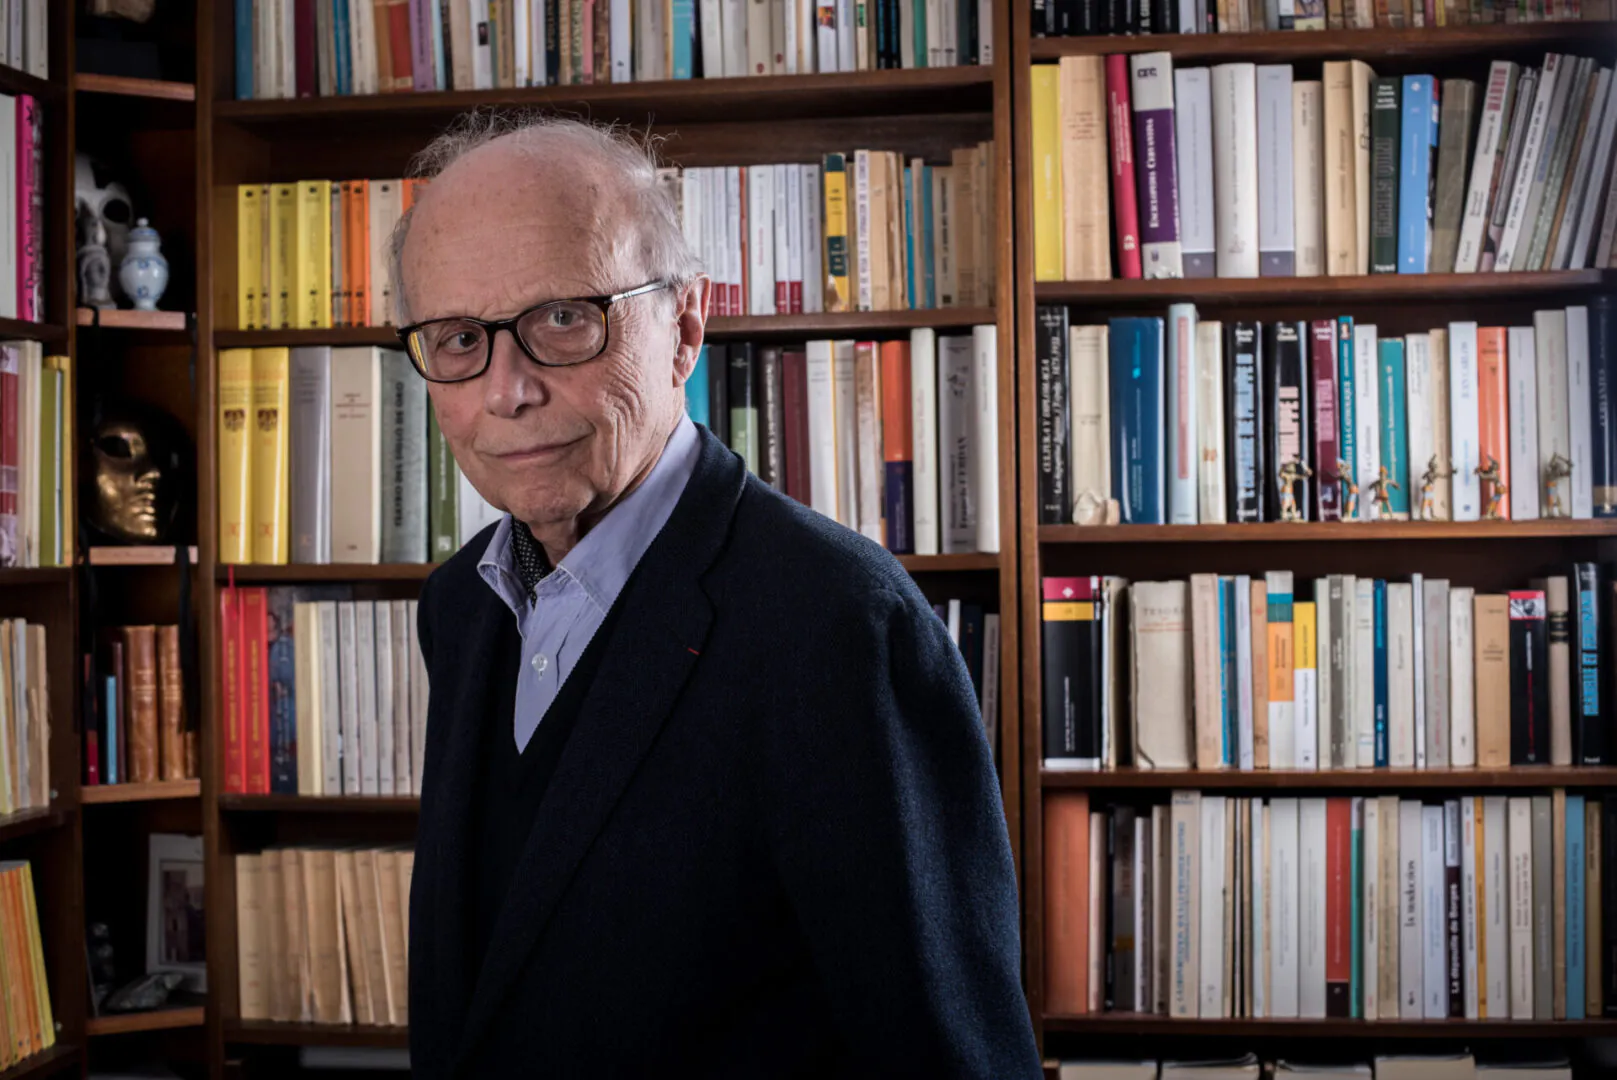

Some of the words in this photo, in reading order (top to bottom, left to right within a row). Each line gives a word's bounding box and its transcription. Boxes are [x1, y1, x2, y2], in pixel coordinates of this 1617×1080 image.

[1487, 67, 1507, 112] MADRID
[395, 382, 404, 408] ORO
[395, 411, 404, 424] DE
[394, 427, 403, 460] SIGLO
[395, 463, 403, 483] DEL
[395, 486, 403, 527] TEATRO
[1449, 883, 1459, 918] Borges
[1449, 920, 1459, 932] de
[1451, 982, 1459, 993] La
